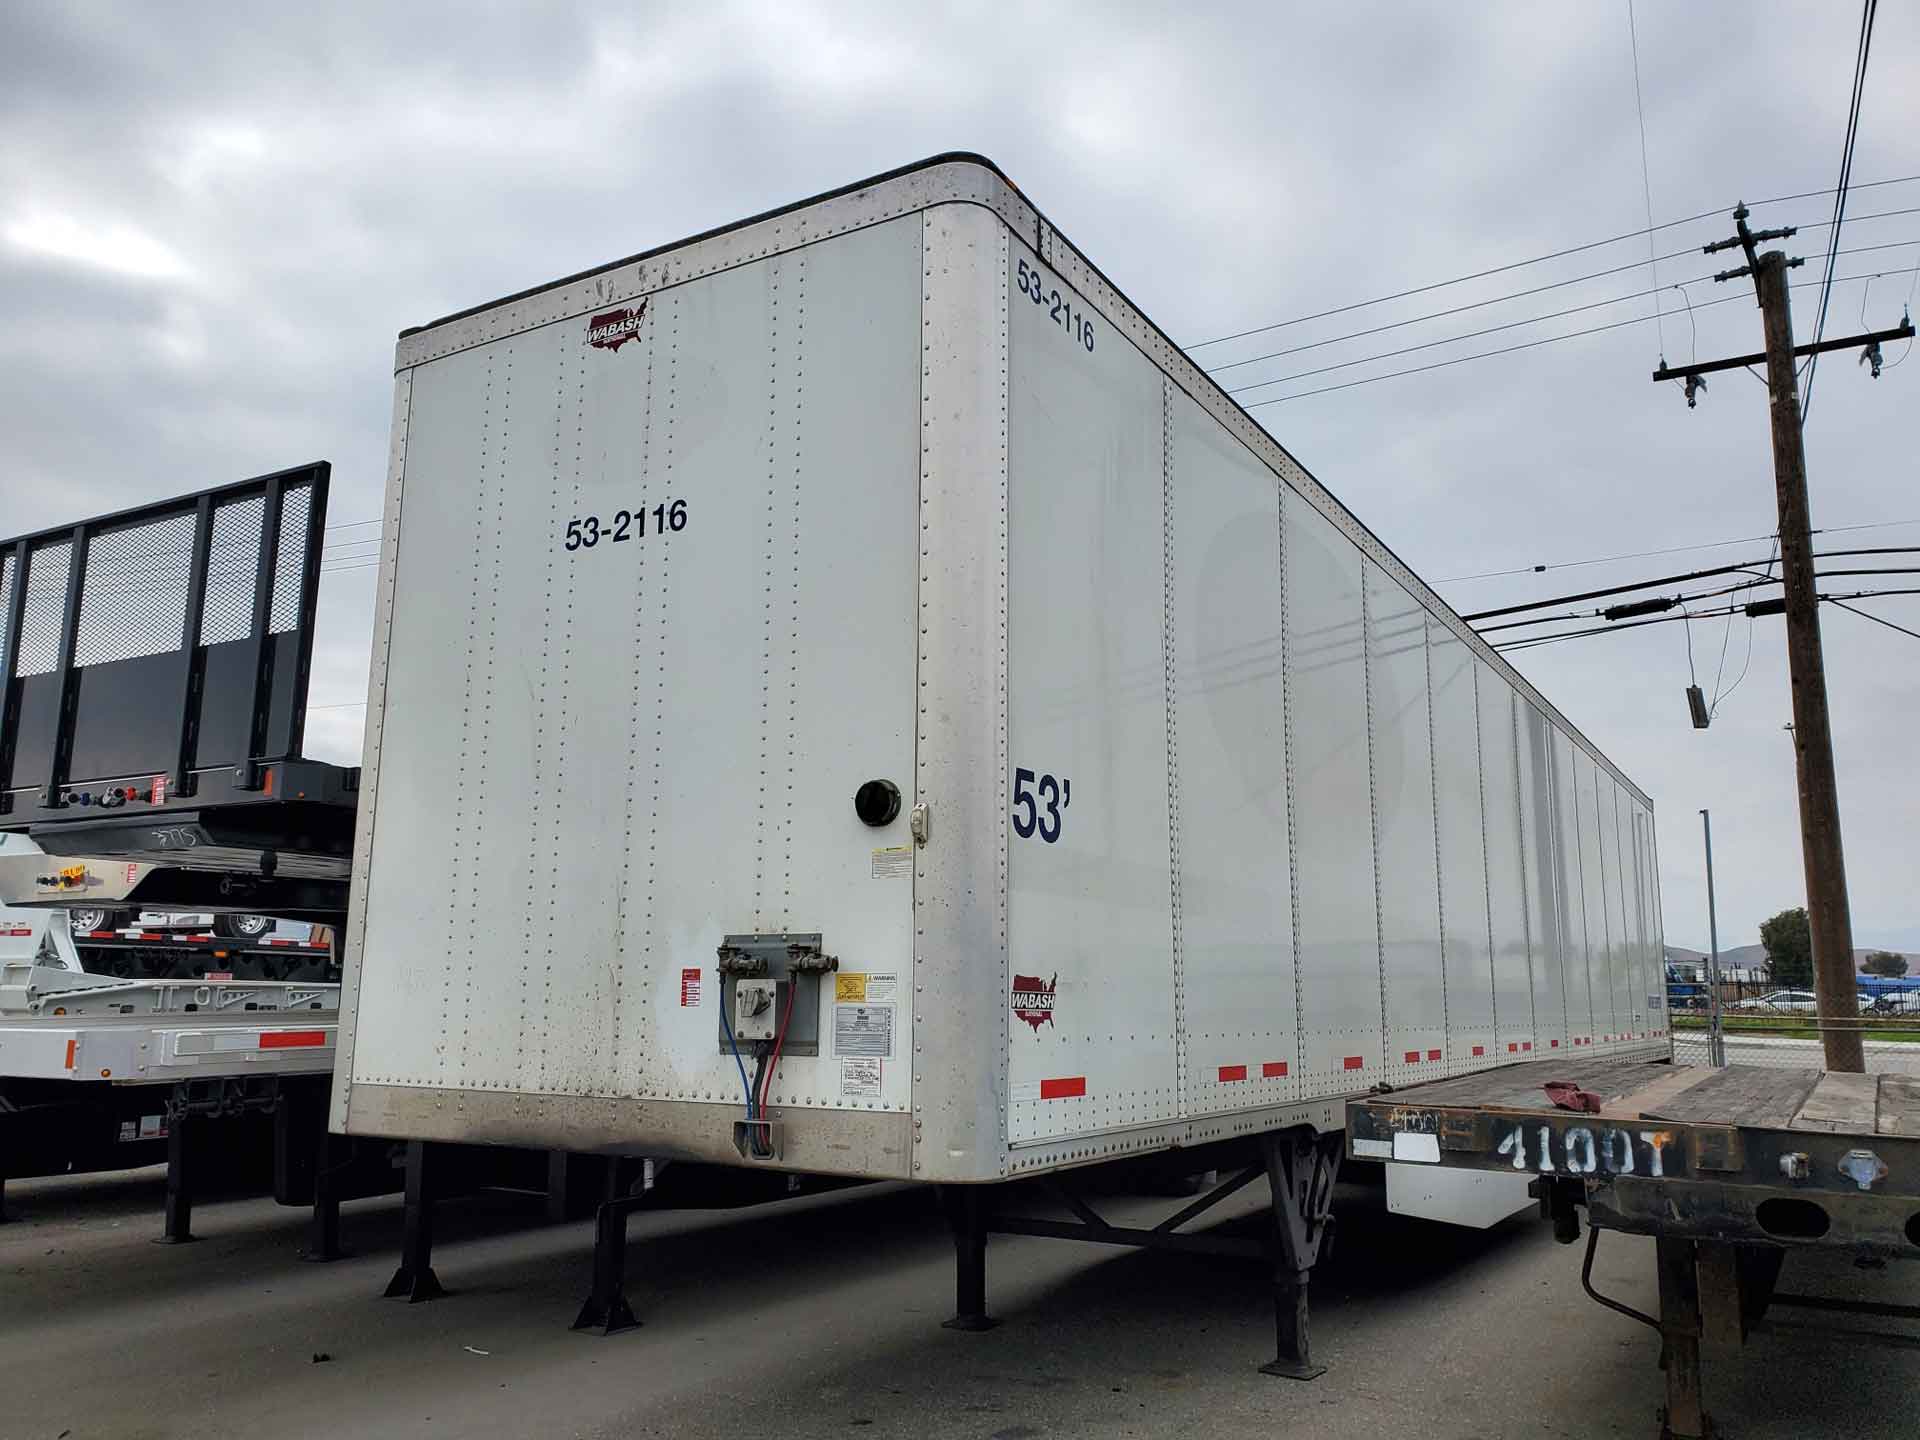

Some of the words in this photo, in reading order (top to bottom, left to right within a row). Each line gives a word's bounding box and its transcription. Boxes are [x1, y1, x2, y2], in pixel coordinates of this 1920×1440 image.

[587, 315, 645, 342] WABASH
[1017, 258, 1094, 352] 53-2116
[565, 499, 687, 551] 53-2116
[1012, 767, 1070, 843] 53'
[1011, 993, 1055, 1009] WABASH
